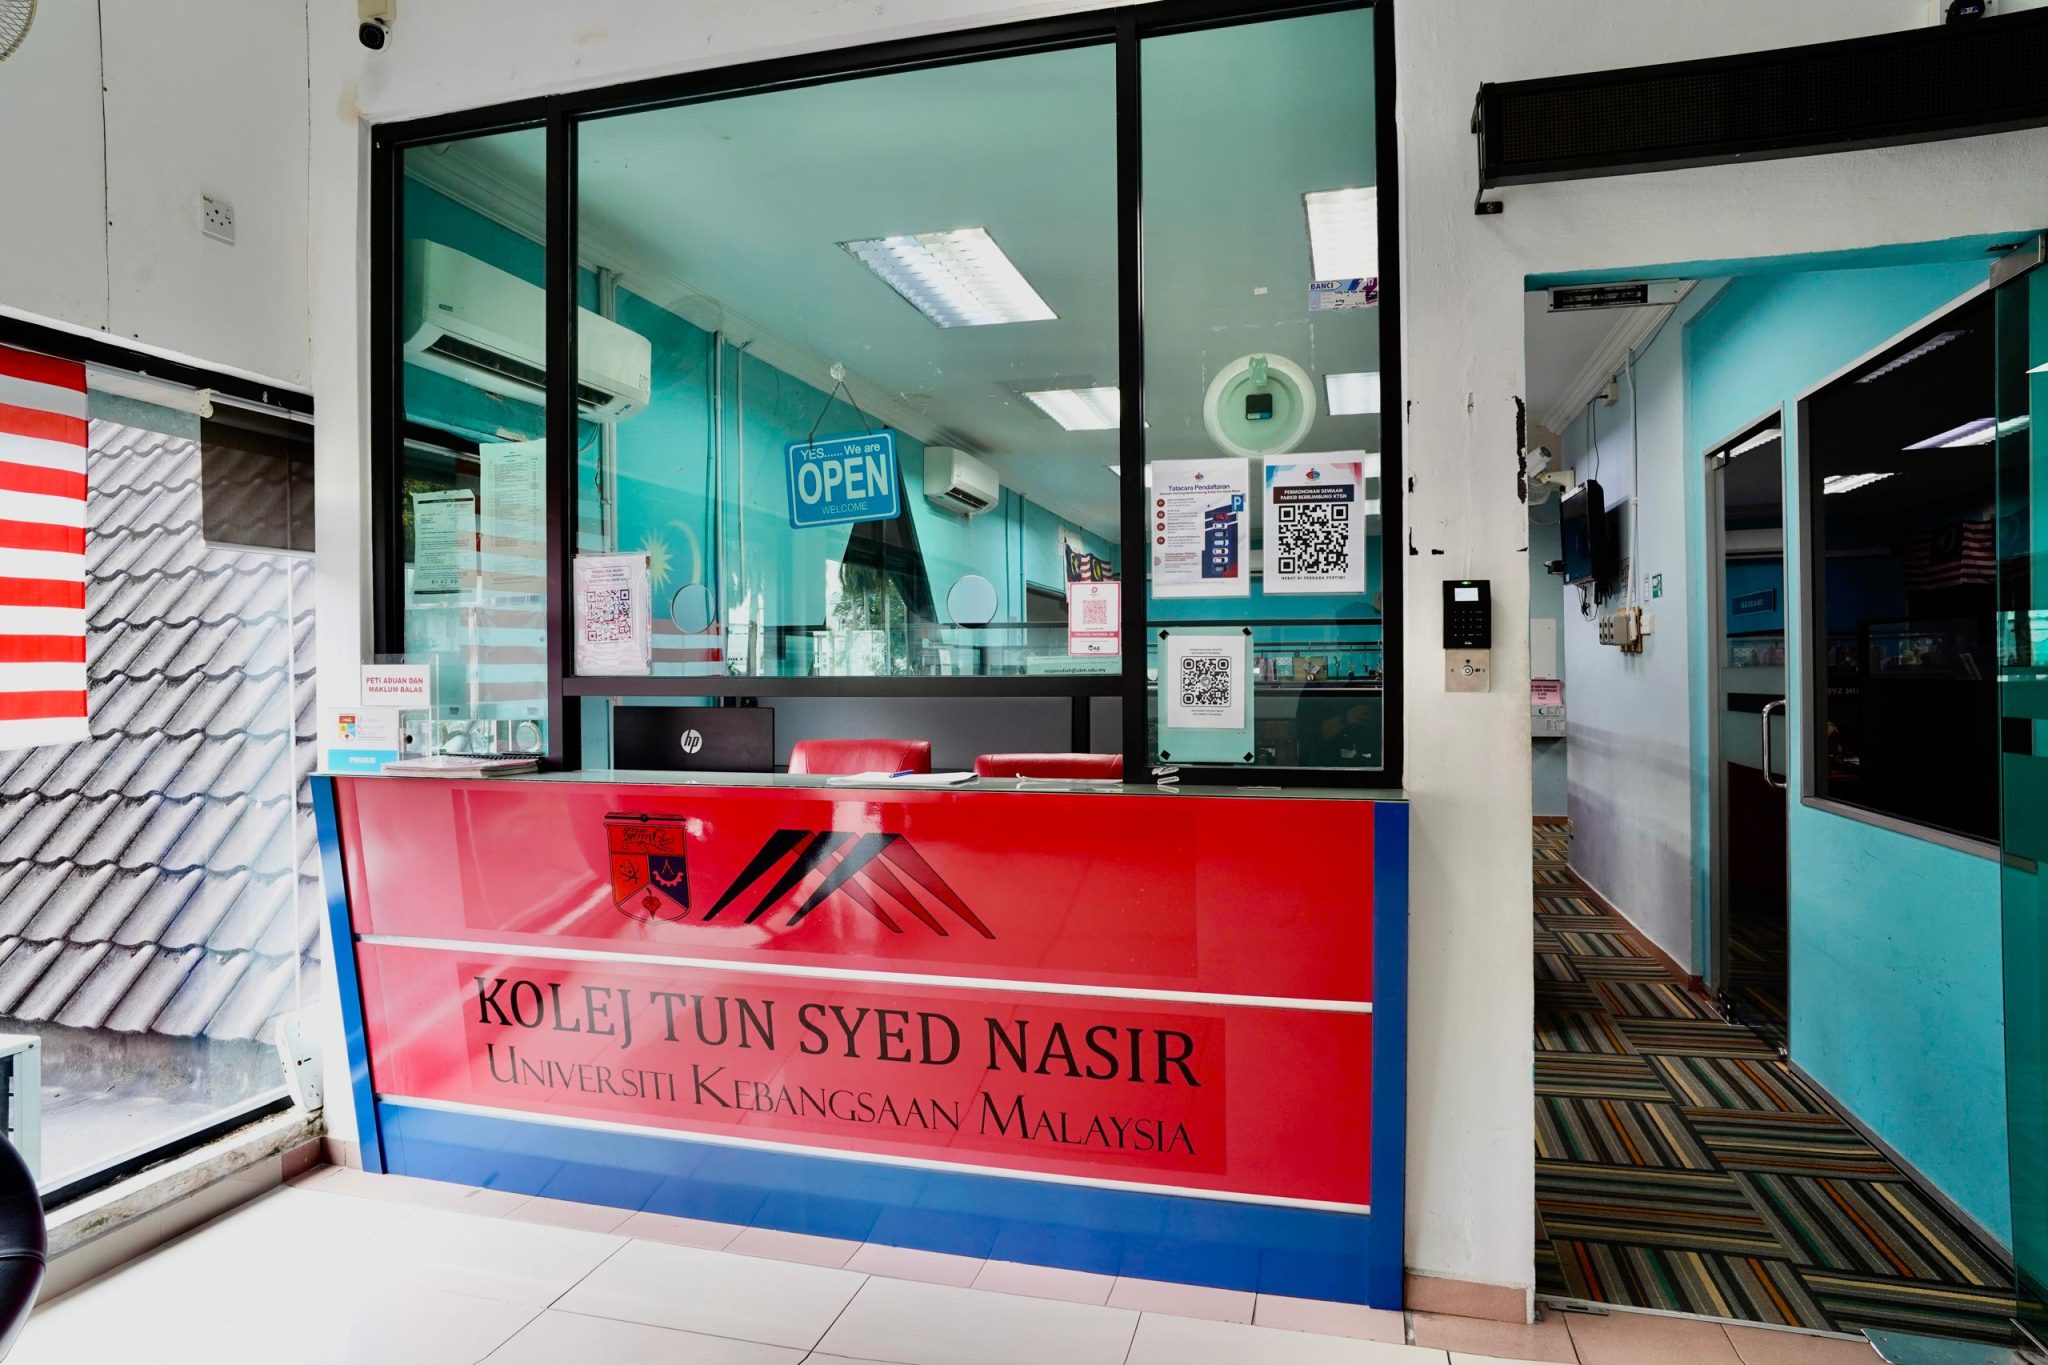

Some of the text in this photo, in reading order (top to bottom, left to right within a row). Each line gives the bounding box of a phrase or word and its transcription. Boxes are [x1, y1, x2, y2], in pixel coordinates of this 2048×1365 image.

[1310, 282, 1334, 290] BANCI
[844, 444, 861, 455] We
[864, 443, 881, 453] are
[798, 454, 889, 505] OPEN
[1194, 483, 1230, 491] Pendaftaran
[822, 501, 869, 515] WELCOME
[1234, 496, 1242, 510] P
[684, 728, 700, 754] hp
[474, 976, 1201, 1087] KOLEJ TUN SYED NASIR
[487, 1044, 1197, 1155] UNIVERSITI KEBANGSAAN MALAYSIA
